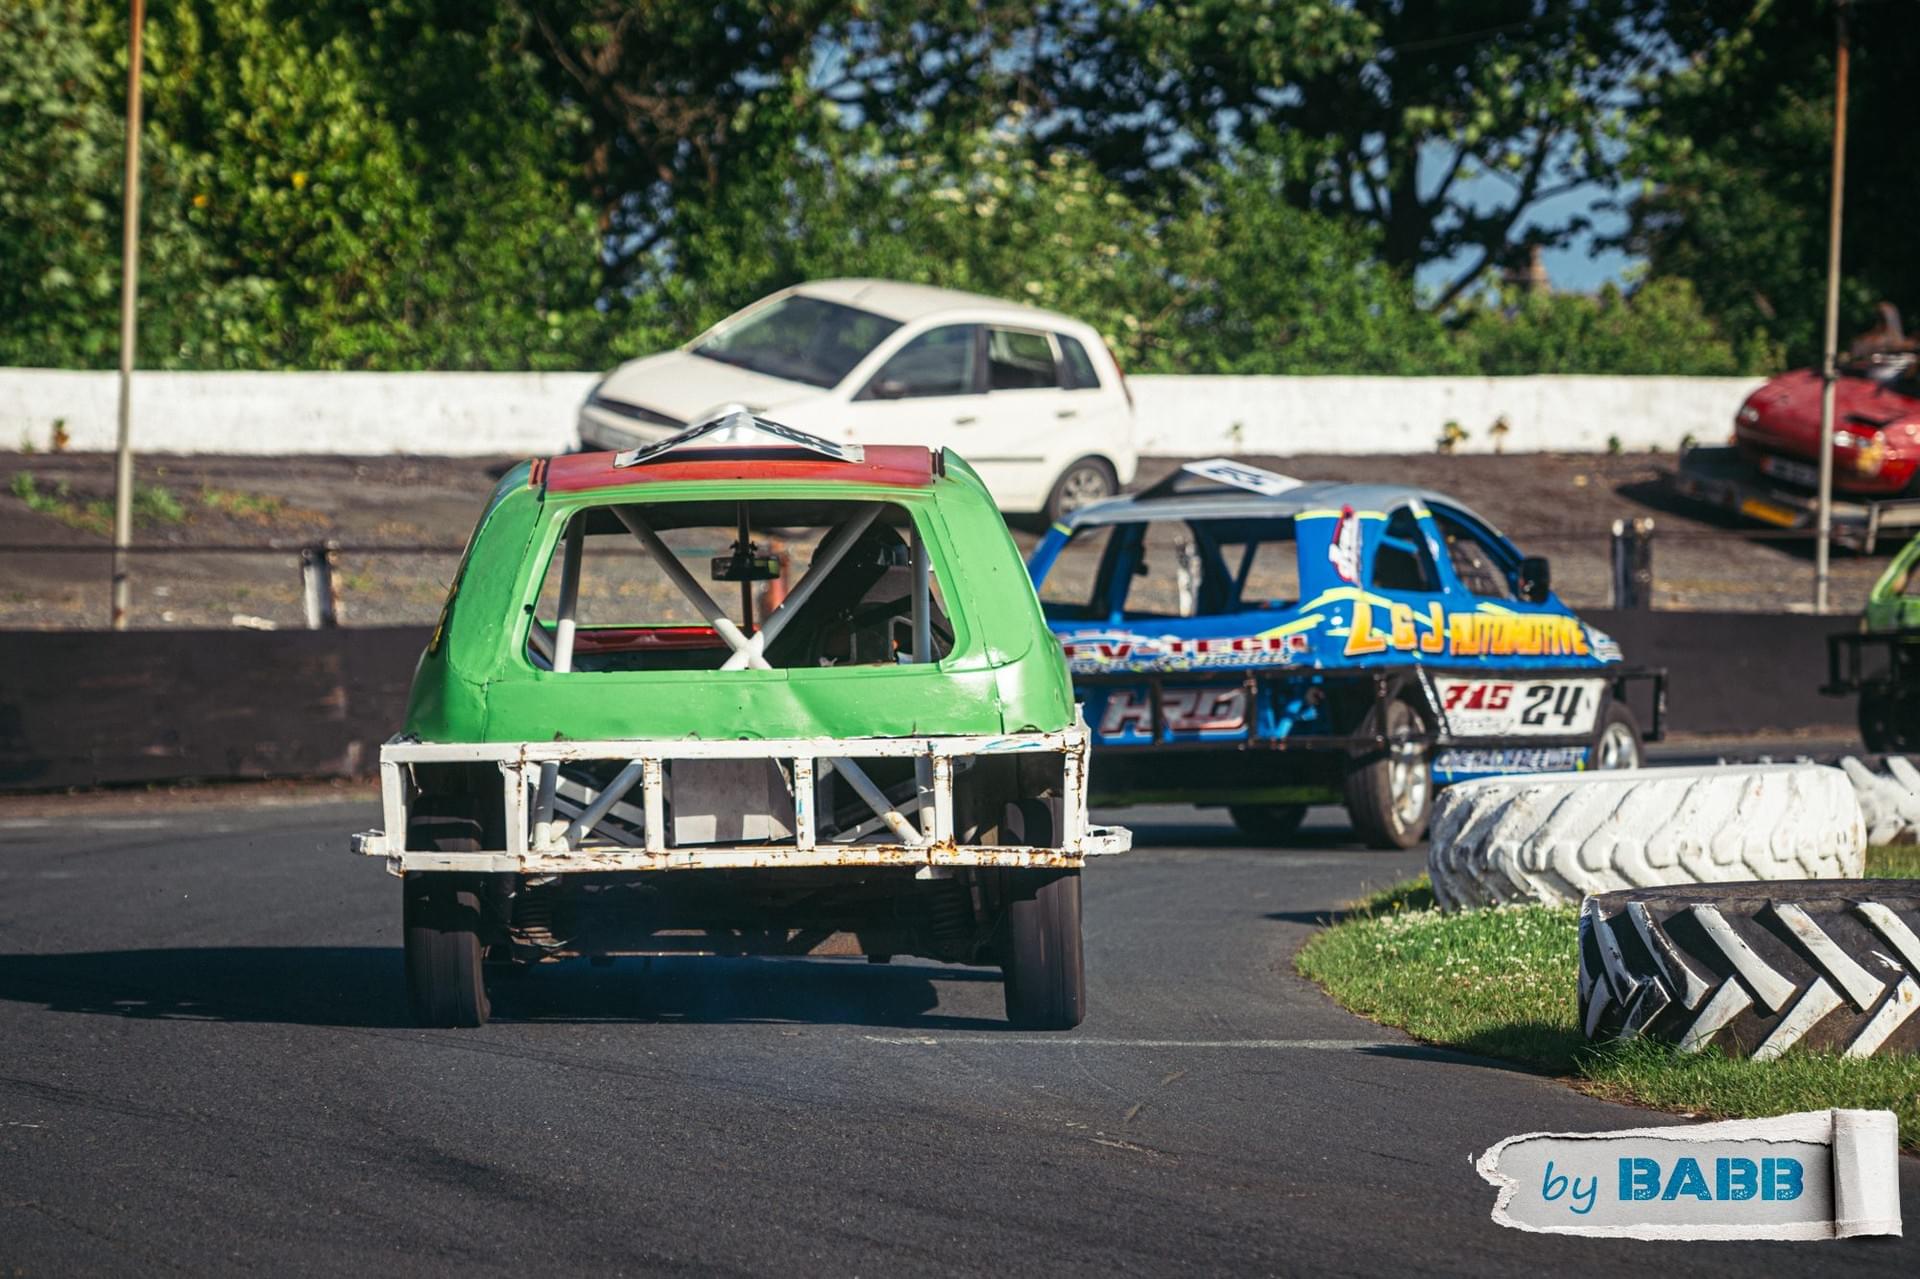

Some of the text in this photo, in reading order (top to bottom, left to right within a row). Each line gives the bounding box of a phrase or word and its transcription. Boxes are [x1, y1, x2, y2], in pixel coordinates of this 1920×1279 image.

[1449, 612, 1589, 656] AUTOMOTIVE
[1445, 684, 1515, 711] 715
[1521, 685, 1583, 726] 24
